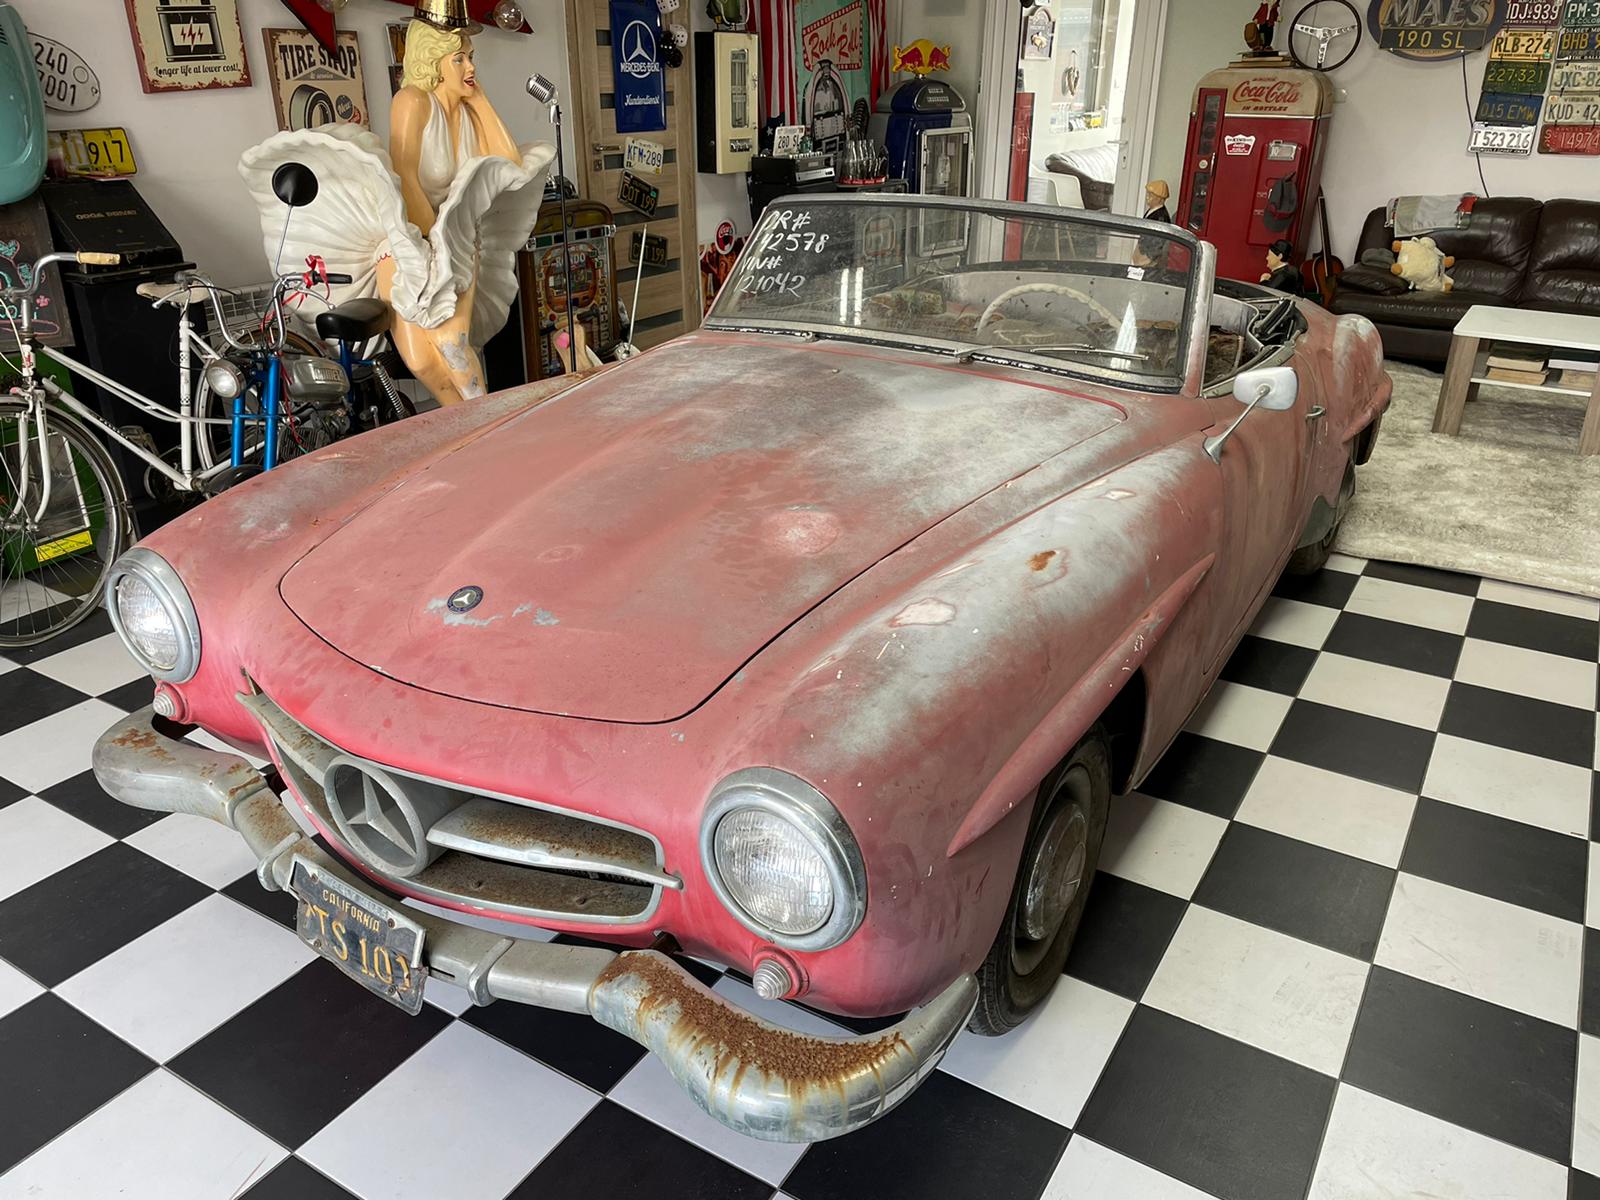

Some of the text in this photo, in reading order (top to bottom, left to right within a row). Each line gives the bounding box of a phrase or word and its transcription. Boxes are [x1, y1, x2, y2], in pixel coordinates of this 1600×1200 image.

[808, 21, 859, 64] Rock Roll
[1398, 30, 1465, 49] 190 SL
[1494, 37, 1552, 54] RLB-274
[34, 42, 68, 75] 240
[278, 44, 316, 80] TIRE
[620, 62, 660, 73] MERCEDES-BENZ
[154, 66, 179, 78] Longer
[180, 65, 192, 76] life
[193, 65, 202, 73] at
[202, 64, 222, 73] lower
[1232, 80, 1302, 103] Coca-Cola
[777, 135, 790, 149] 280
[1482, 131, 1506, 147] 523
[1506, 133, 1531, 148] 216
[322, 889, 381, 933] CALIFORNIA
